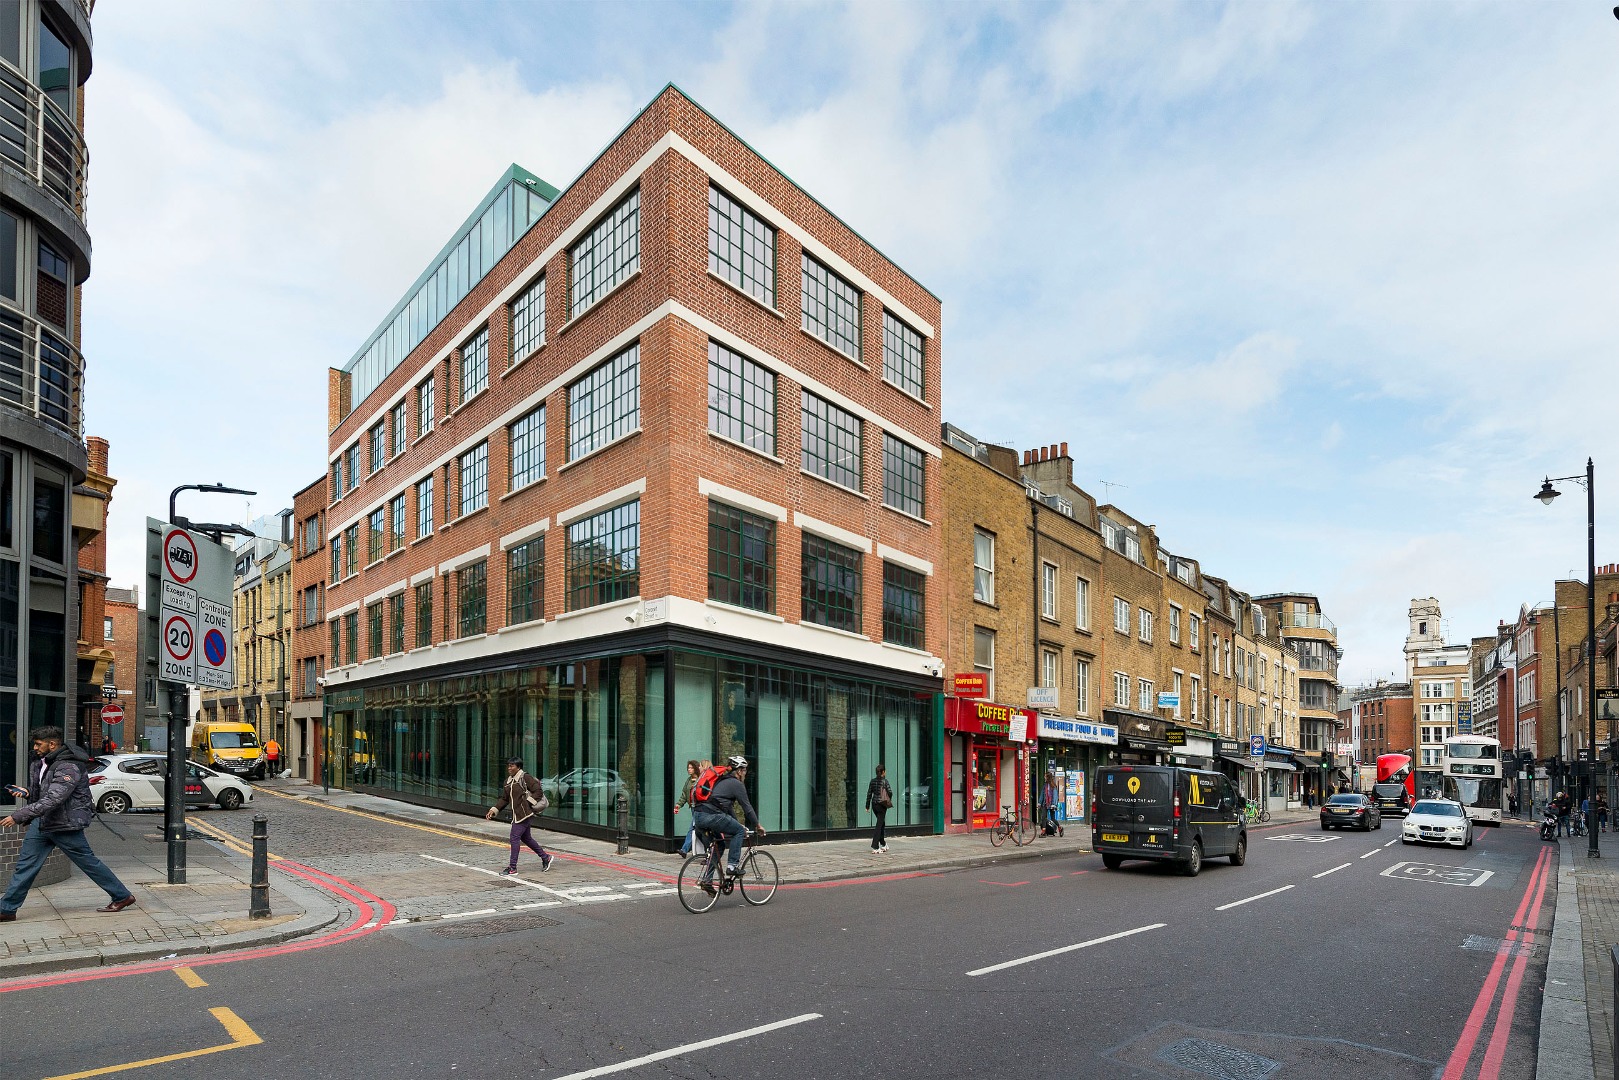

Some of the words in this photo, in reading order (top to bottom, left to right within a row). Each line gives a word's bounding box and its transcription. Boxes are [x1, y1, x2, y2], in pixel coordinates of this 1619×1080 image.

[177, 548, 192, 561] 7.5T
[165, 585, 186, 598] Except
[187, 591, 195, 600] for
[169, 595, 191, 609] loading
[200, 601, 231, 617] Controlled
[204, 613, 227, 628] ZONE
[169, 627, 190, 649] 20
[165, 662, 192, 677] ZONE
[978, 703, 1006, 720] COFFEE
[1075, 724, 1091, 734] FOOD
[1092, 726, 1098, 736] &
[1100, 728, 1116, 738] WINE
